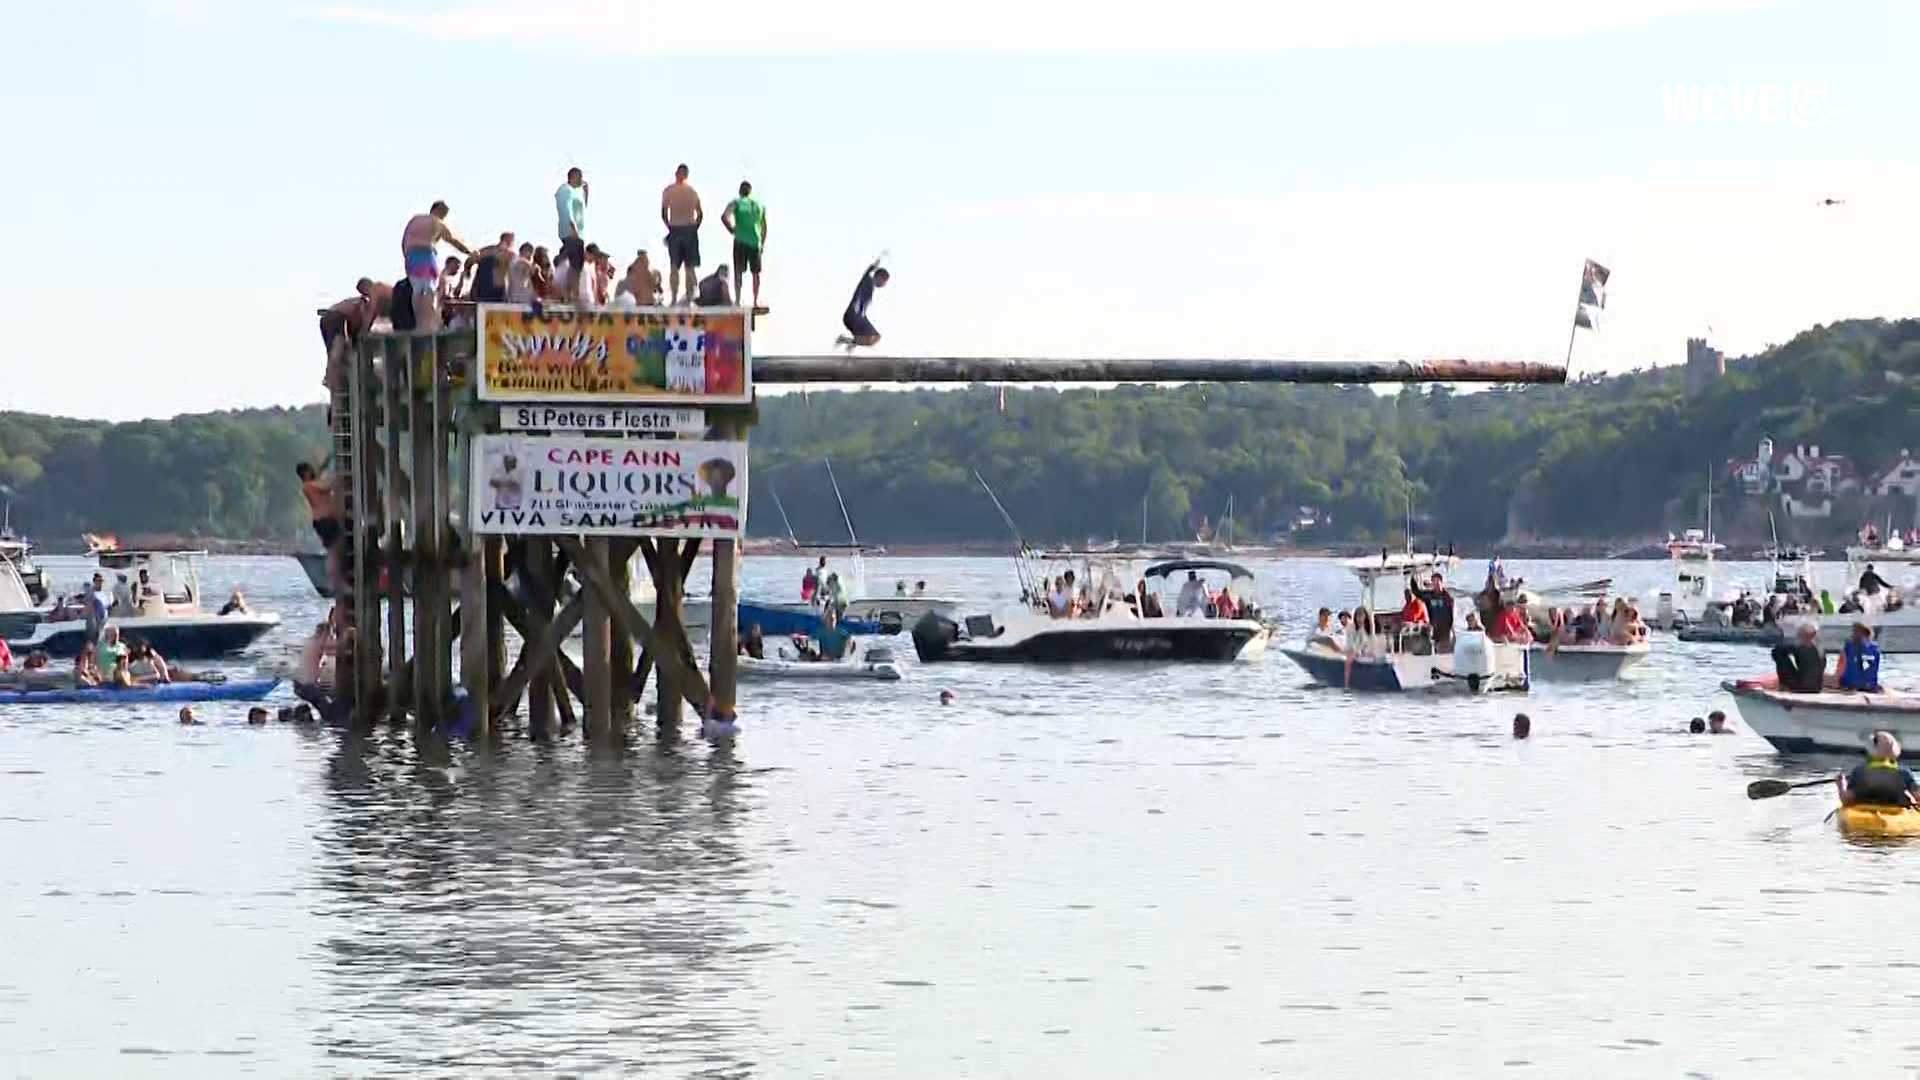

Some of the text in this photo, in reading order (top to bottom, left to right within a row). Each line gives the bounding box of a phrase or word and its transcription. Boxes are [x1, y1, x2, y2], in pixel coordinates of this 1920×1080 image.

[518, 409, 536, 426] St
[544, 409, 606, 427] Peters
[613, 410, 671, 428] Fiesta
[548, 448, 681, 467] CAPE ANN
[534, 469, 696, 499] LIQUORS
[481, 511, 545, 527] VIVA
[560, 512, 617, 528] SAN
